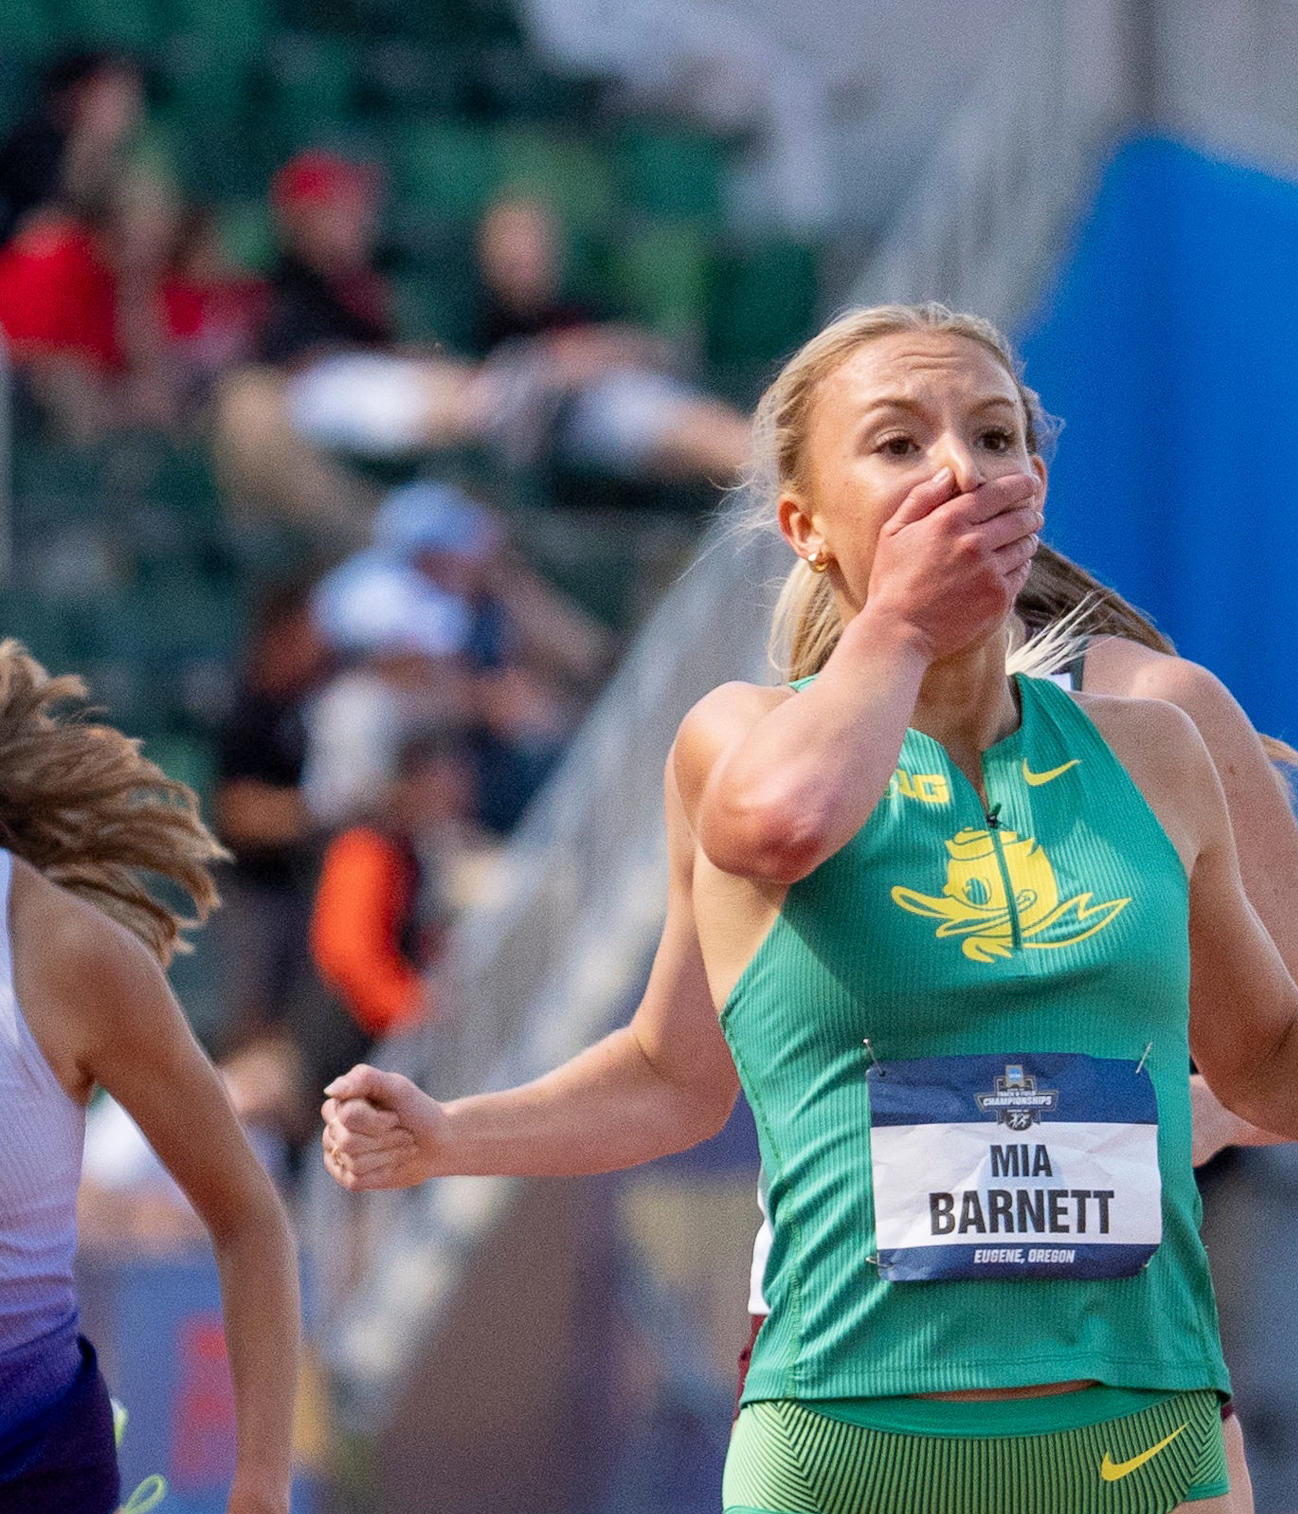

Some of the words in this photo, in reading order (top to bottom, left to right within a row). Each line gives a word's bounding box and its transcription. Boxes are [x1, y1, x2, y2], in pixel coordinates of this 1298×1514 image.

[983, 1095, 1052, 1107] CHAMPIONSHIPS
[990, 1144, 1053, 1178] MIA
[929, 1189, 1115, 1236] BARNETT
[974, 1249, 1025, 1264] EUGENE,
[1028, 1249, 1075, 1263] OREGON
